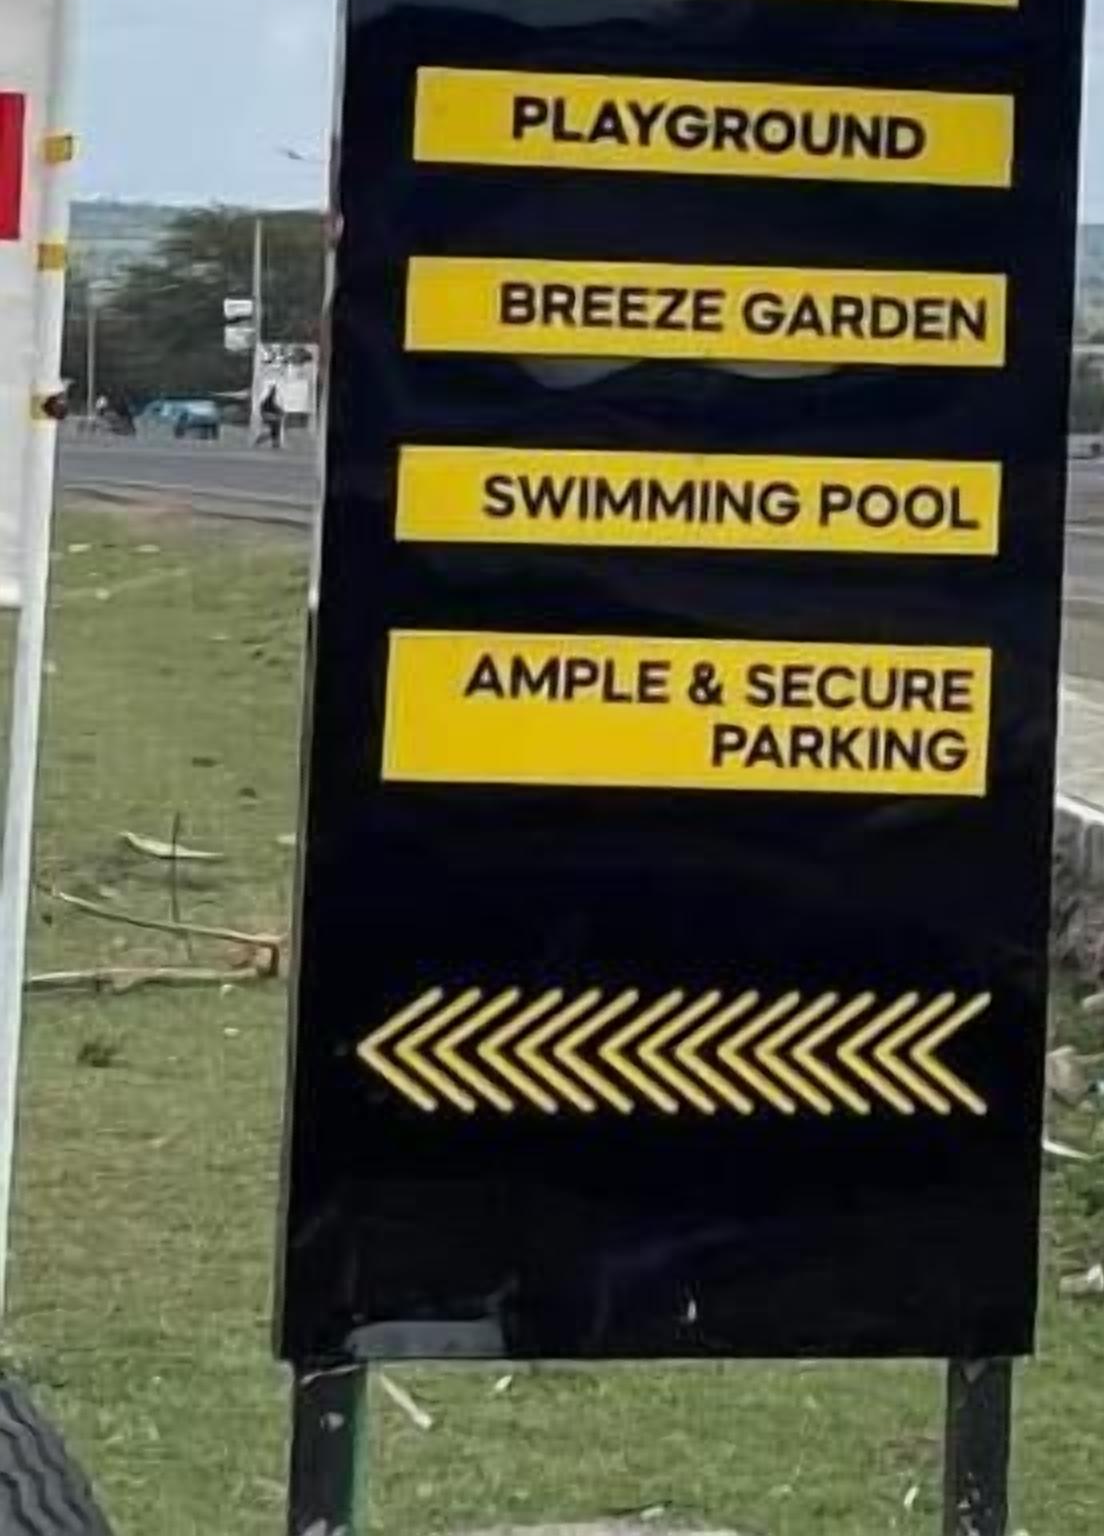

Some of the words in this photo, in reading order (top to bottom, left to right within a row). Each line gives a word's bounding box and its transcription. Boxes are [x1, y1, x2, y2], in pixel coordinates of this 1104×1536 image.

[511, 95, 927, 161] PLAYGROUND
[500, 281, 726, 332] BREEZE
[742, 292, 987, 342] GARDEN
[482, 474, 800, 527] SWIMMING
[818, 482, 980, 530] POOL
[463, 653, 672, 705] AMPLE
[688, 661, 724, 706] &
[745, 664, 973, 712] SECURE
[710, 722, 968, 772] PARKING
